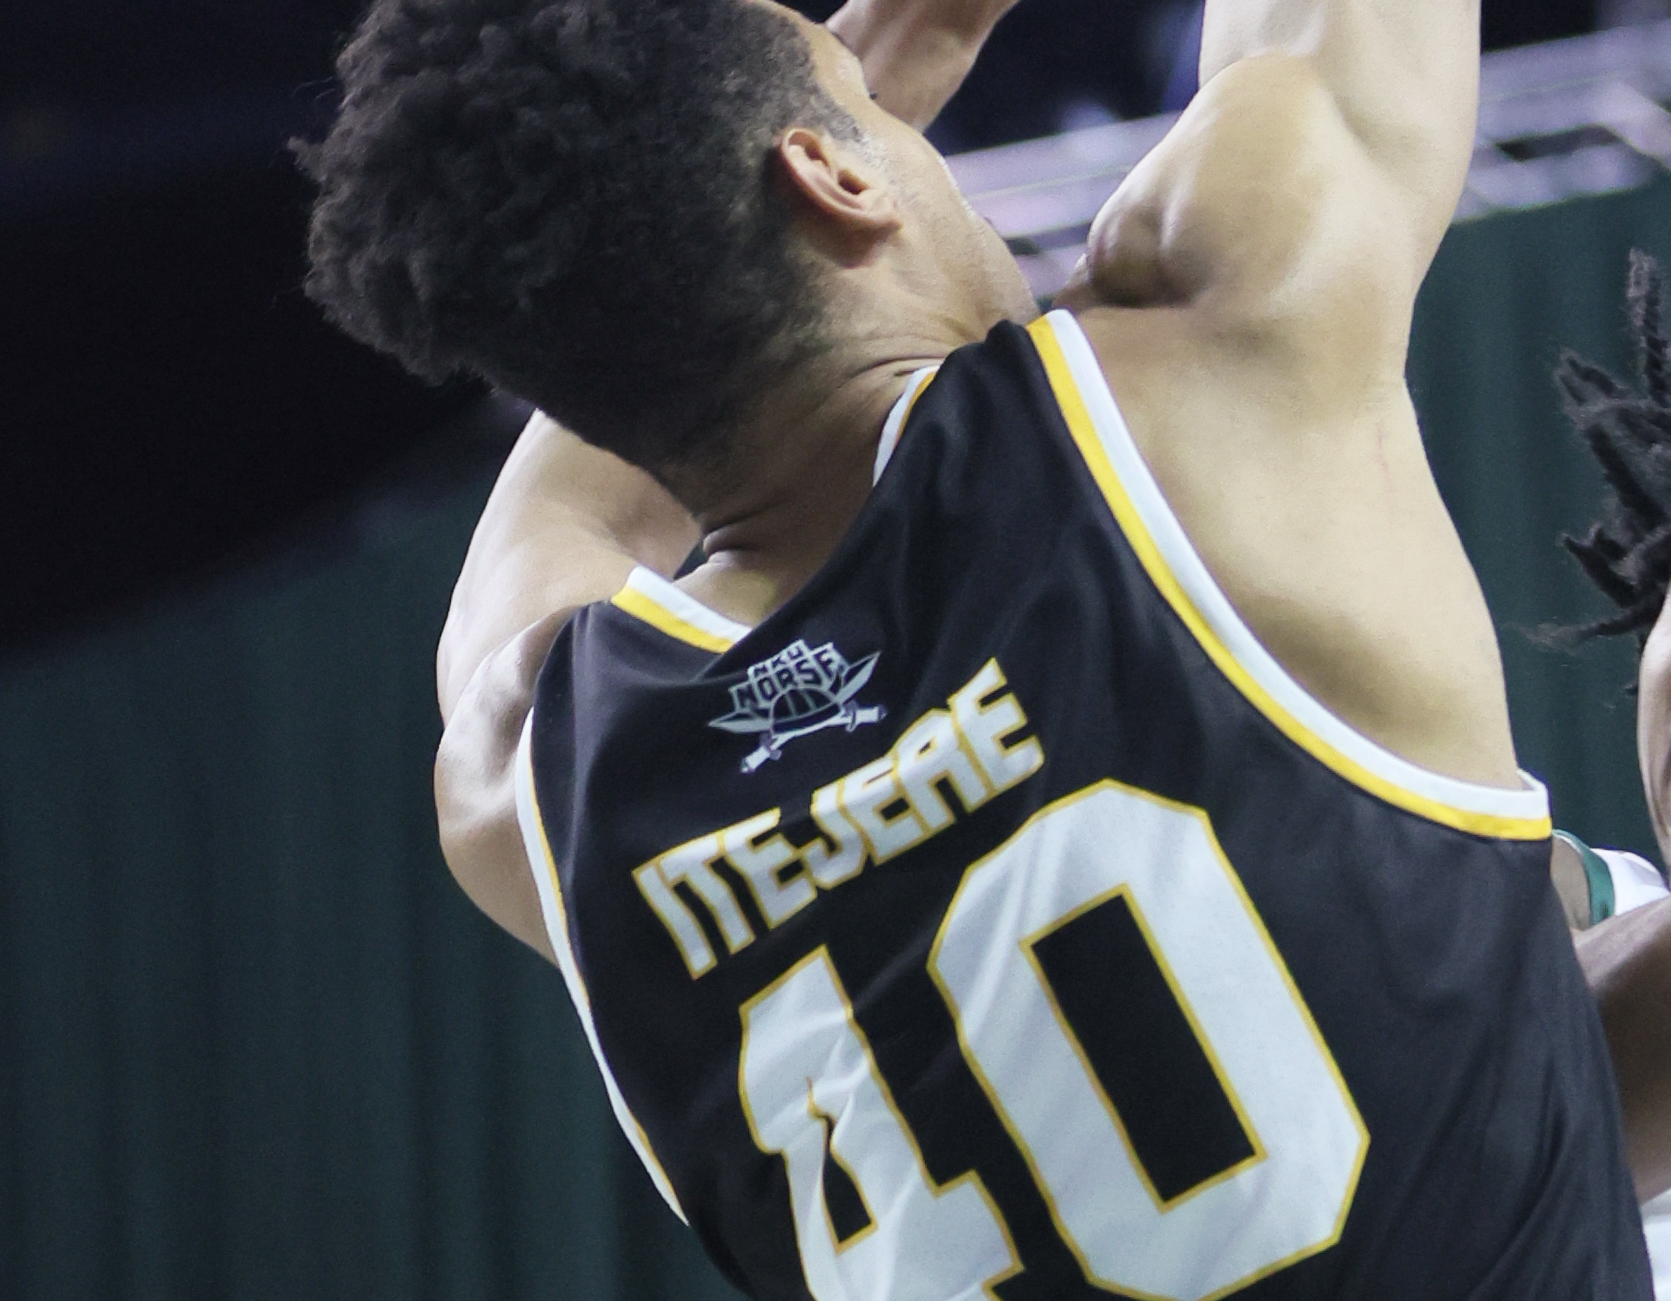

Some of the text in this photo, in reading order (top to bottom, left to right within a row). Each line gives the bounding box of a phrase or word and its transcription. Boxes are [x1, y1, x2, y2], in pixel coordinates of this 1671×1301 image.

[731, 644, 849, 715] NORSE
[751, 641, 805, 678] NKU
[632, 657, 1045, 980] ITEJERE
